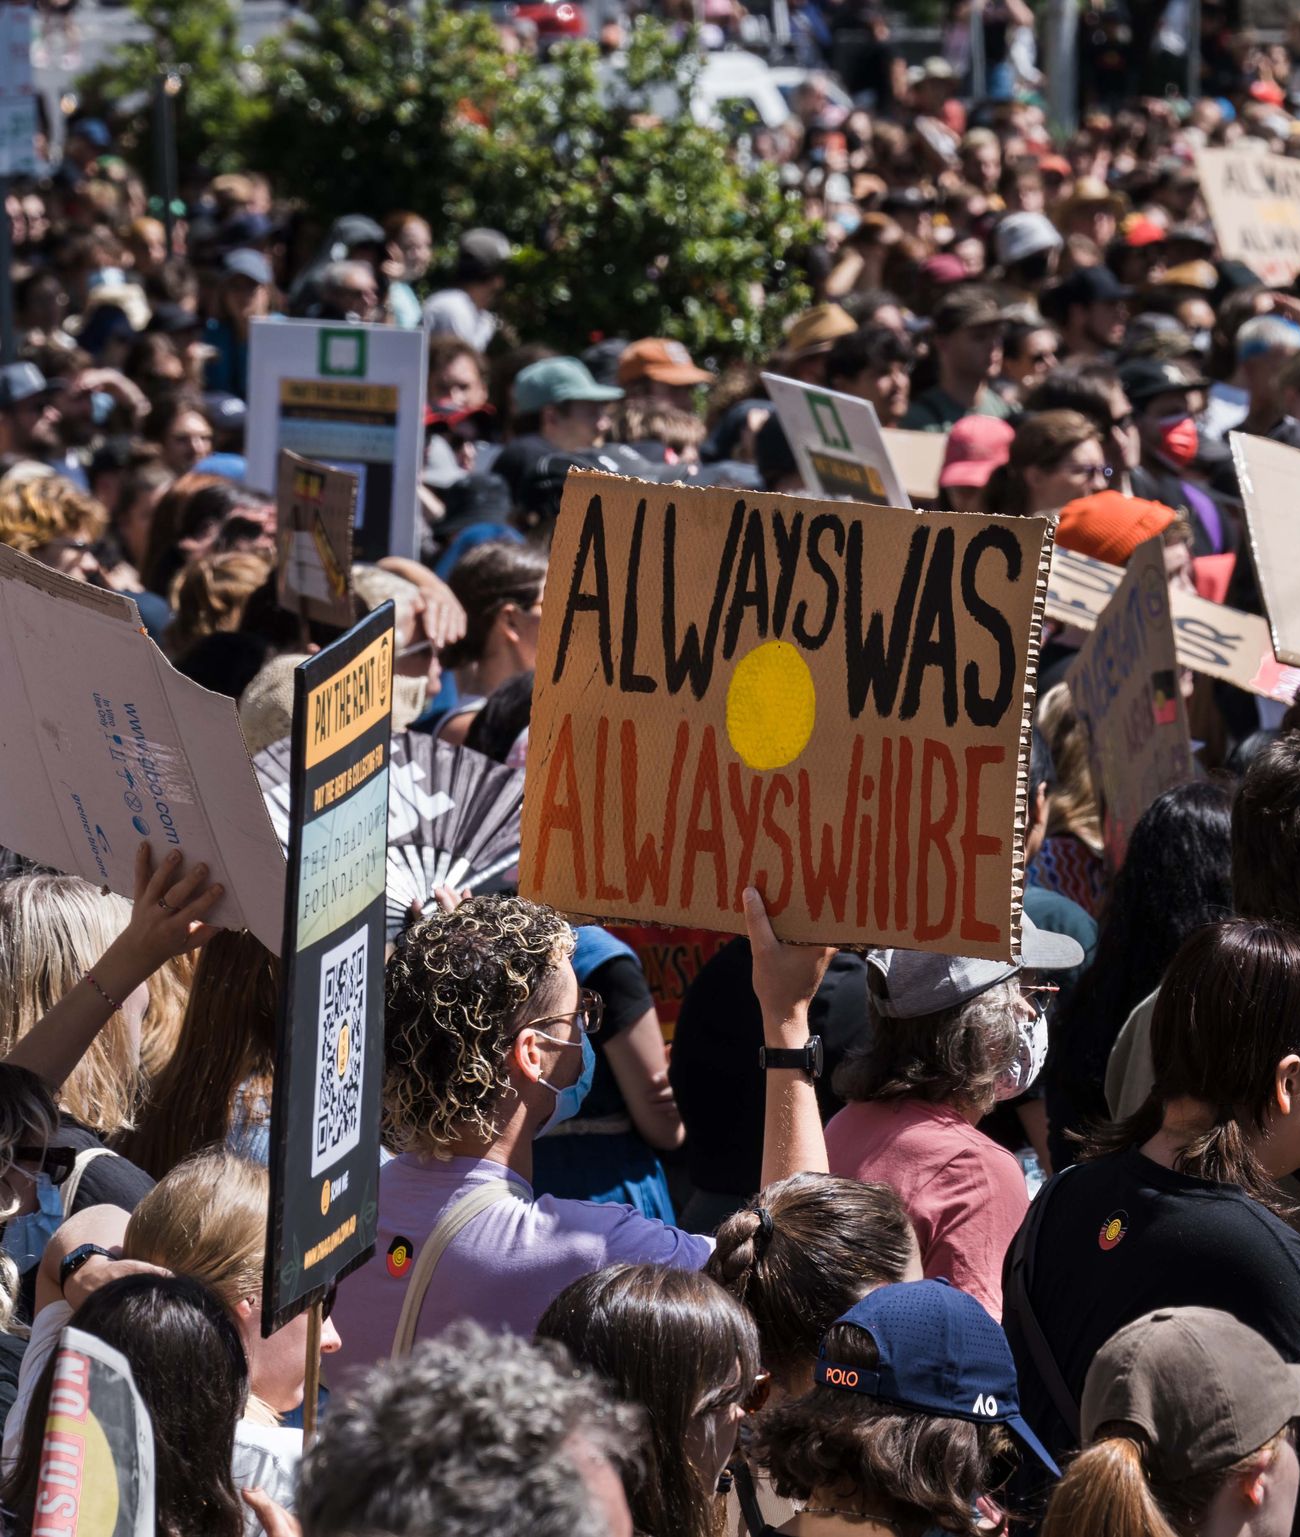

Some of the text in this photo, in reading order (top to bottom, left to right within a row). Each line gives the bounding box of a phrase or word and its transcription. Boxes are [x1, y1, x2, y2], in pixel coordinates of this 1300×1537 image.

[552, 494, 844, 701] ALWAYS
[844, 520, 1023, 727] WAS
[314, 686, 333, 746] PAY
[334, 675, 351, 734] THE
[352, 656, 375, 721] RENT
[123, 702, 180, 845] www.gbo.com
[303, 845, 327, 880] THE
[533, 714, 794, 917] ALWAYS
[913, 738, 1005, 942] BE
[303, 847, 377, 919] FOUNDATION
[826, 1367, 859, 1387] POLO
